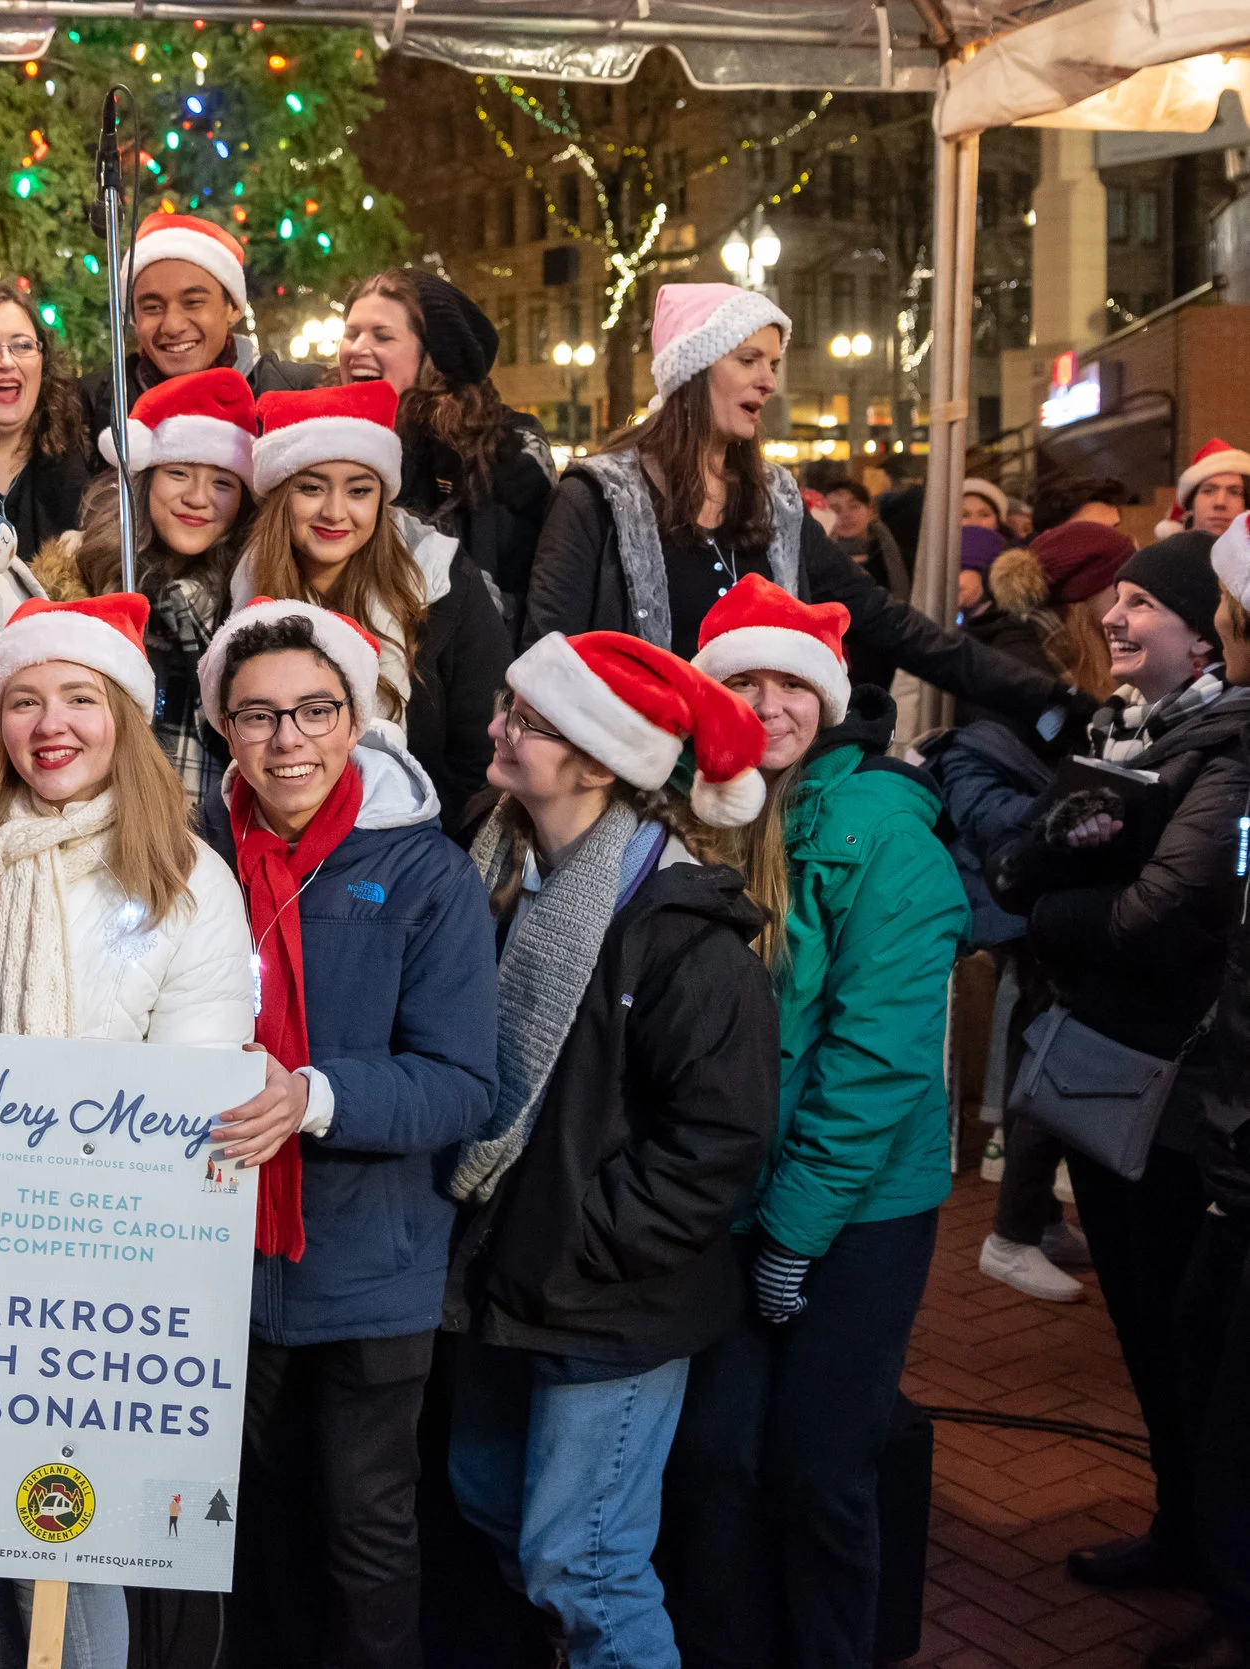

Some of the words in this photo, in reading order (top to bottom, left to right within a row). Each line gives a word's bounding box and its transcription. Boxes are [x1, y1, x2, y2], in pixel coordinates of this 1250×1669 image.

[347, 884, 374, 895] NORTH
[360, 880, 374, 888] THE
[353, 892, 374, 901] FACE
[69, 1089, 213, 1160] Merry
[47, 1155, 125, 1170] COURTHOUSE
[129, 1162, 174, 1173] SQUARE
[17, 1188, 62, 1207] THE
[69, 1192, 143, 1212] GREAT
[0, 1211, 104, 1234] PUDDING
[112, 1220, 231, 1243] CAROLING
[38, 1346, 233, 1391] SCHOOL
[22, 1465, 70, 1492] PORTLAND
[73, 1473, 91, 1497] MALL
[78, 1508, 93, 1528] INC.
[76, 1554, 173, 1569] #THESQUAREPDX
